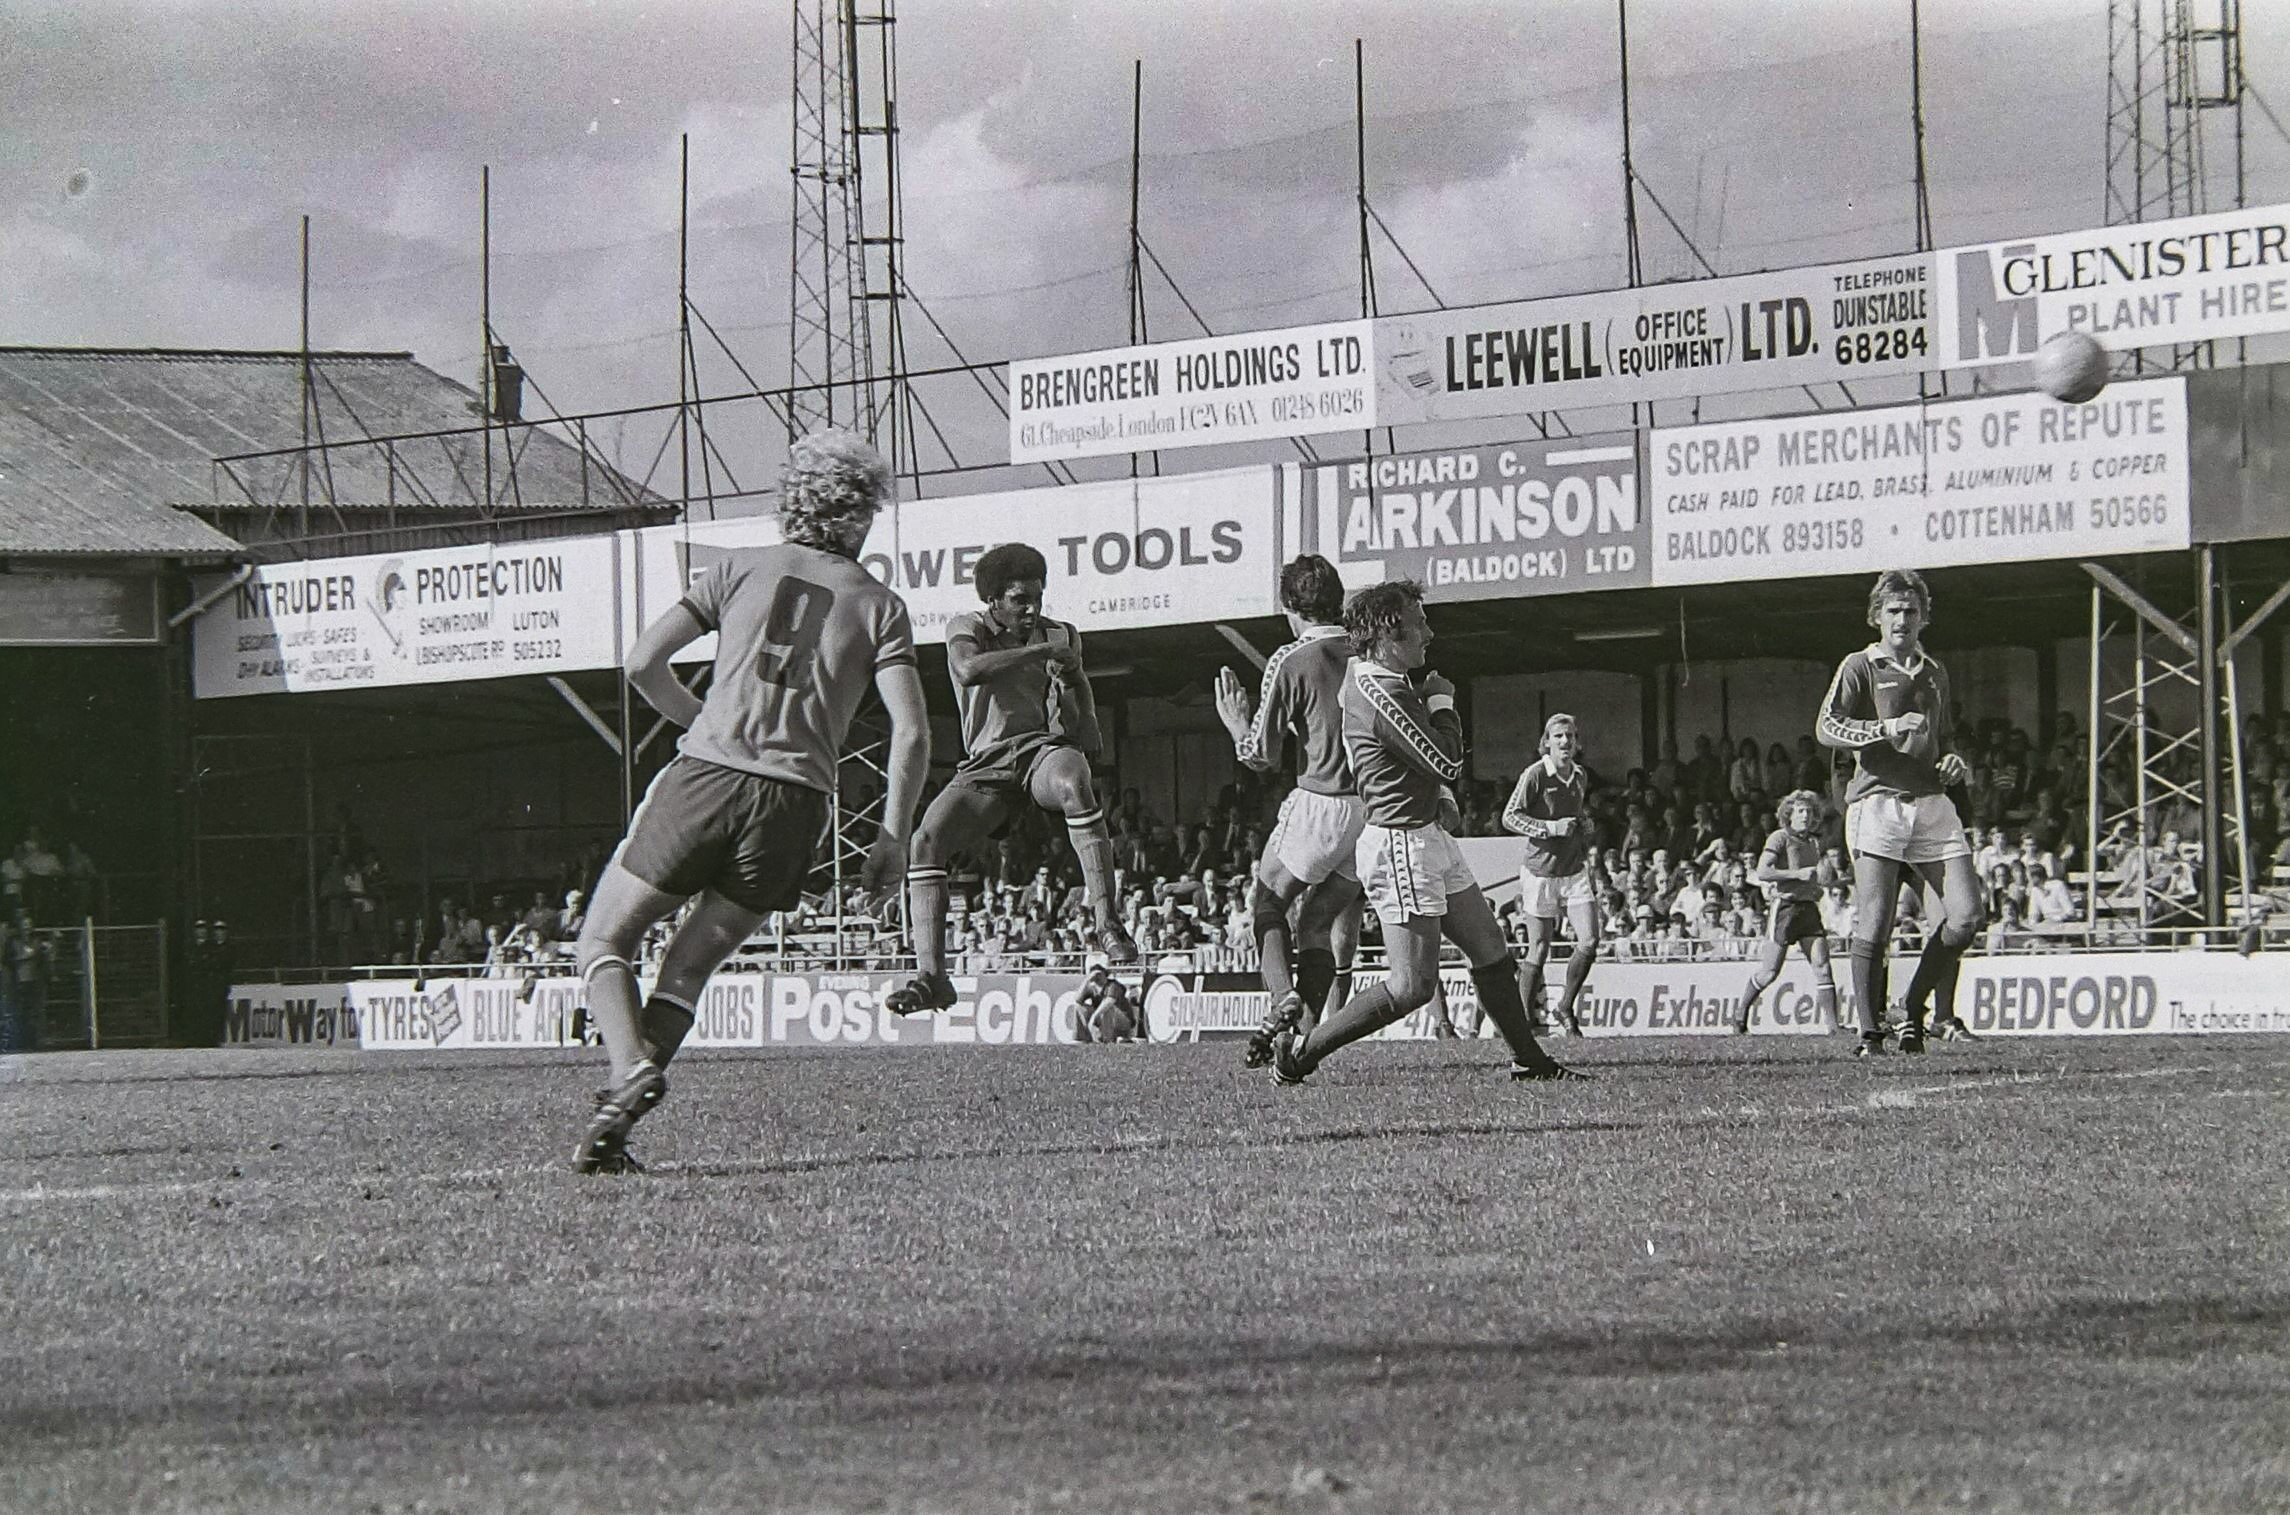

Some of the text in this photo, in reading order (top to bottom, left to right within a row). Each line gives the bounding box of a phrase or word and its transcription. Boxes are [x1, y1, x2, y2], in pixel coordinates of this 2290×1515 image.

[1834, 266, 1927, 292] TELEPHONE
[1636, 307, 1707, 342] OFFICE
[1741, 297, 1819, 363] LTD.
[1833, 289, 1927, 329] DUNSTABLE
[2068, 279, 2288, 333] PLANT HIRE
[1446, 321, 1602, 392] LEEWELL
[1619, 338, 1724, 377] EQUIPMENT
[1835, 326, 1928, 365] 68284
[1020, 336, 1367, 410] BRENGREEN HOLDINGS LTD.
[1320, 387, 1363, 418] 6026
[1667, 398, 2165, 476] SCRAP MERCHANTS OF REPUTE
[1348, 450, 1526, 489] RICHARD C.
[1667, 493, 1708, 514] CASH
[1720, 488, 1758, 509] PAID
[1771, 485, 1804, 507] FOR
[1945, 463, 2053, 492] ALUMINIUM
[2069, 461, 2079, 480] &
[2093, 453, 2167, 480] COPPER
[1667, 493, 2167, 561] BALDOCK 893158 COTTENHAM 50566
[861, 520, 1243, 590] OWE TOOLS
[1427, 545, 1635, 586] (BALDOCK) LTD
[236, 556, 562, 620] INTRUDER PROTECTION
[1089, 594, 1171, 614] CAMBRIDGE
[419, 608, 560, 635] SHOWROOM LUTON
[757, 574, 836, 689] 9
[368, 995, 433, 1041] TYRES
[473, 988, 523, 1042] BLUE
[698, 985, 754, 1040] JOBS
[1576, 983, 1638, 1027] Euro
[1649, 983, 1761, 1029] Exhaut
[1974, 975, 2157, 1031] BEDFORD
[2169, 1000, 2196, 1029] The
